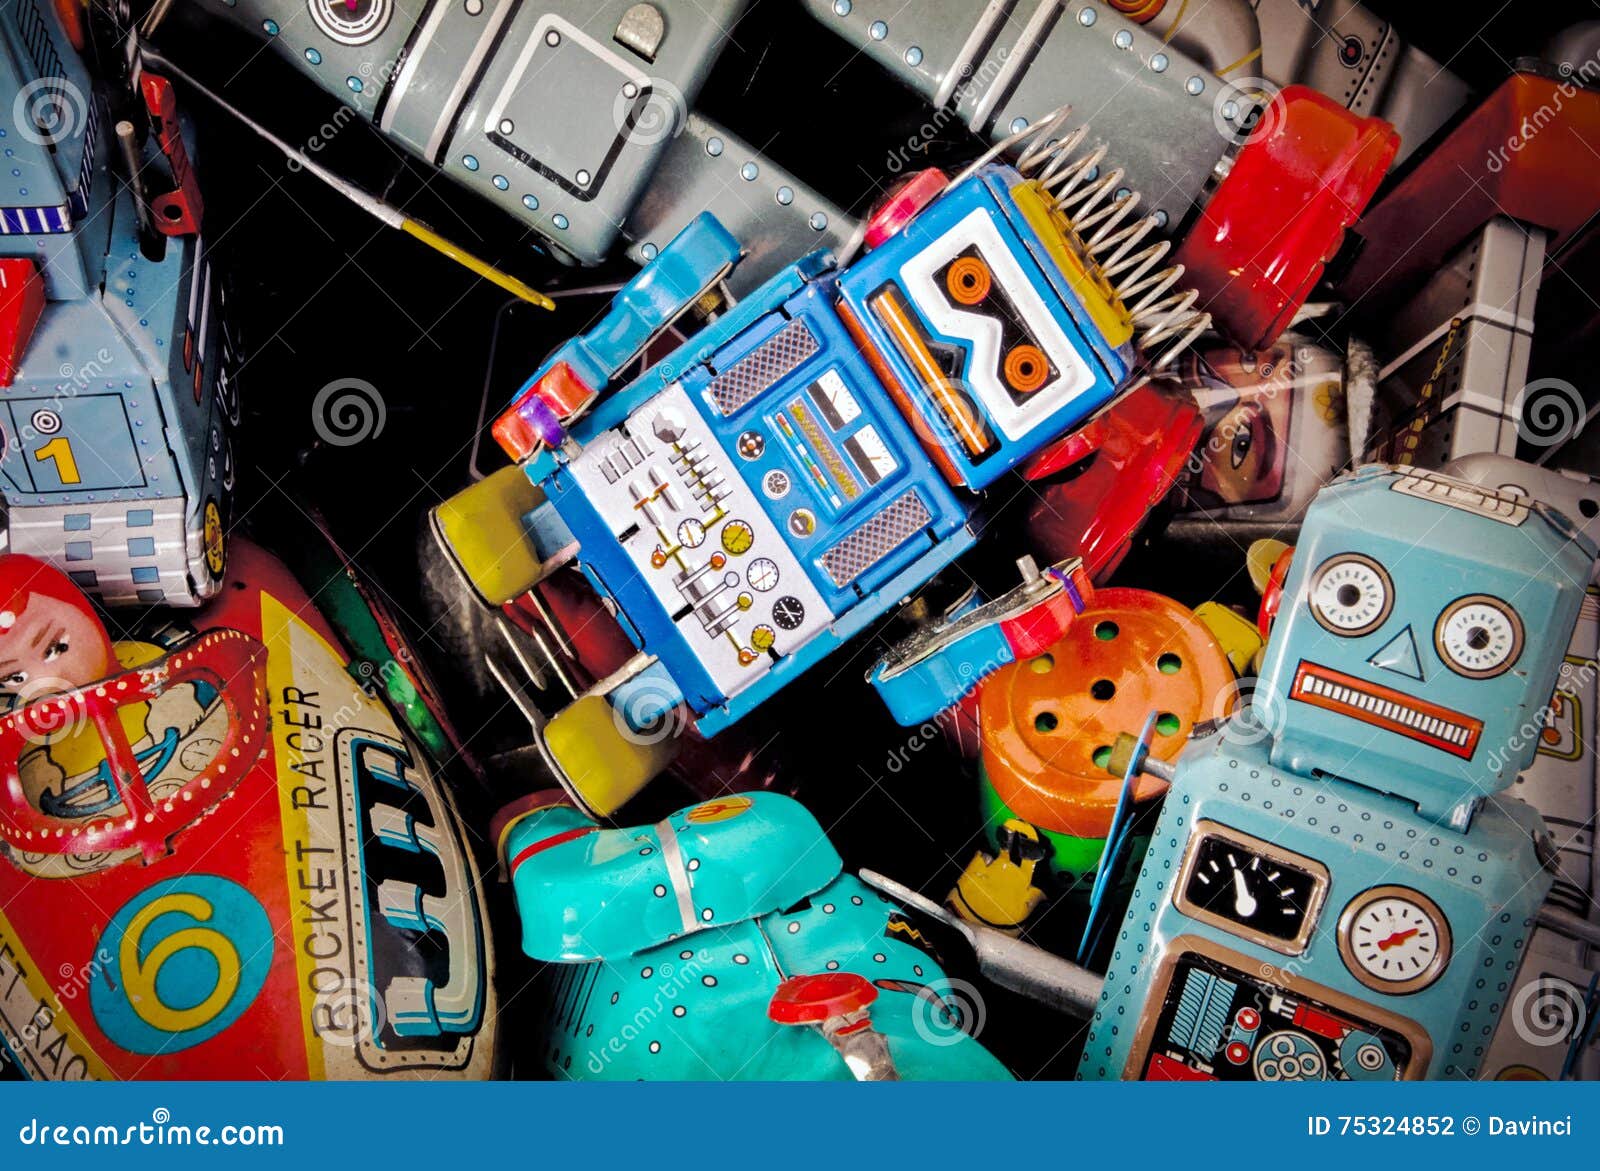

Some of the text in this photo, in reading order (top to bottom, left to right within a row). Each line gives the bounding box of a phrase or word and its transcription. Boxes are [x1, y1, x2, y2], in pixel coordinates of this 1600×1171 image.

[34, 436, 81, 484] 1
[283, 686, 346, 1038] ROCKET RACER
[119, 892, 241, 1033] 6
[27, 998, 101, 1081] RAC
